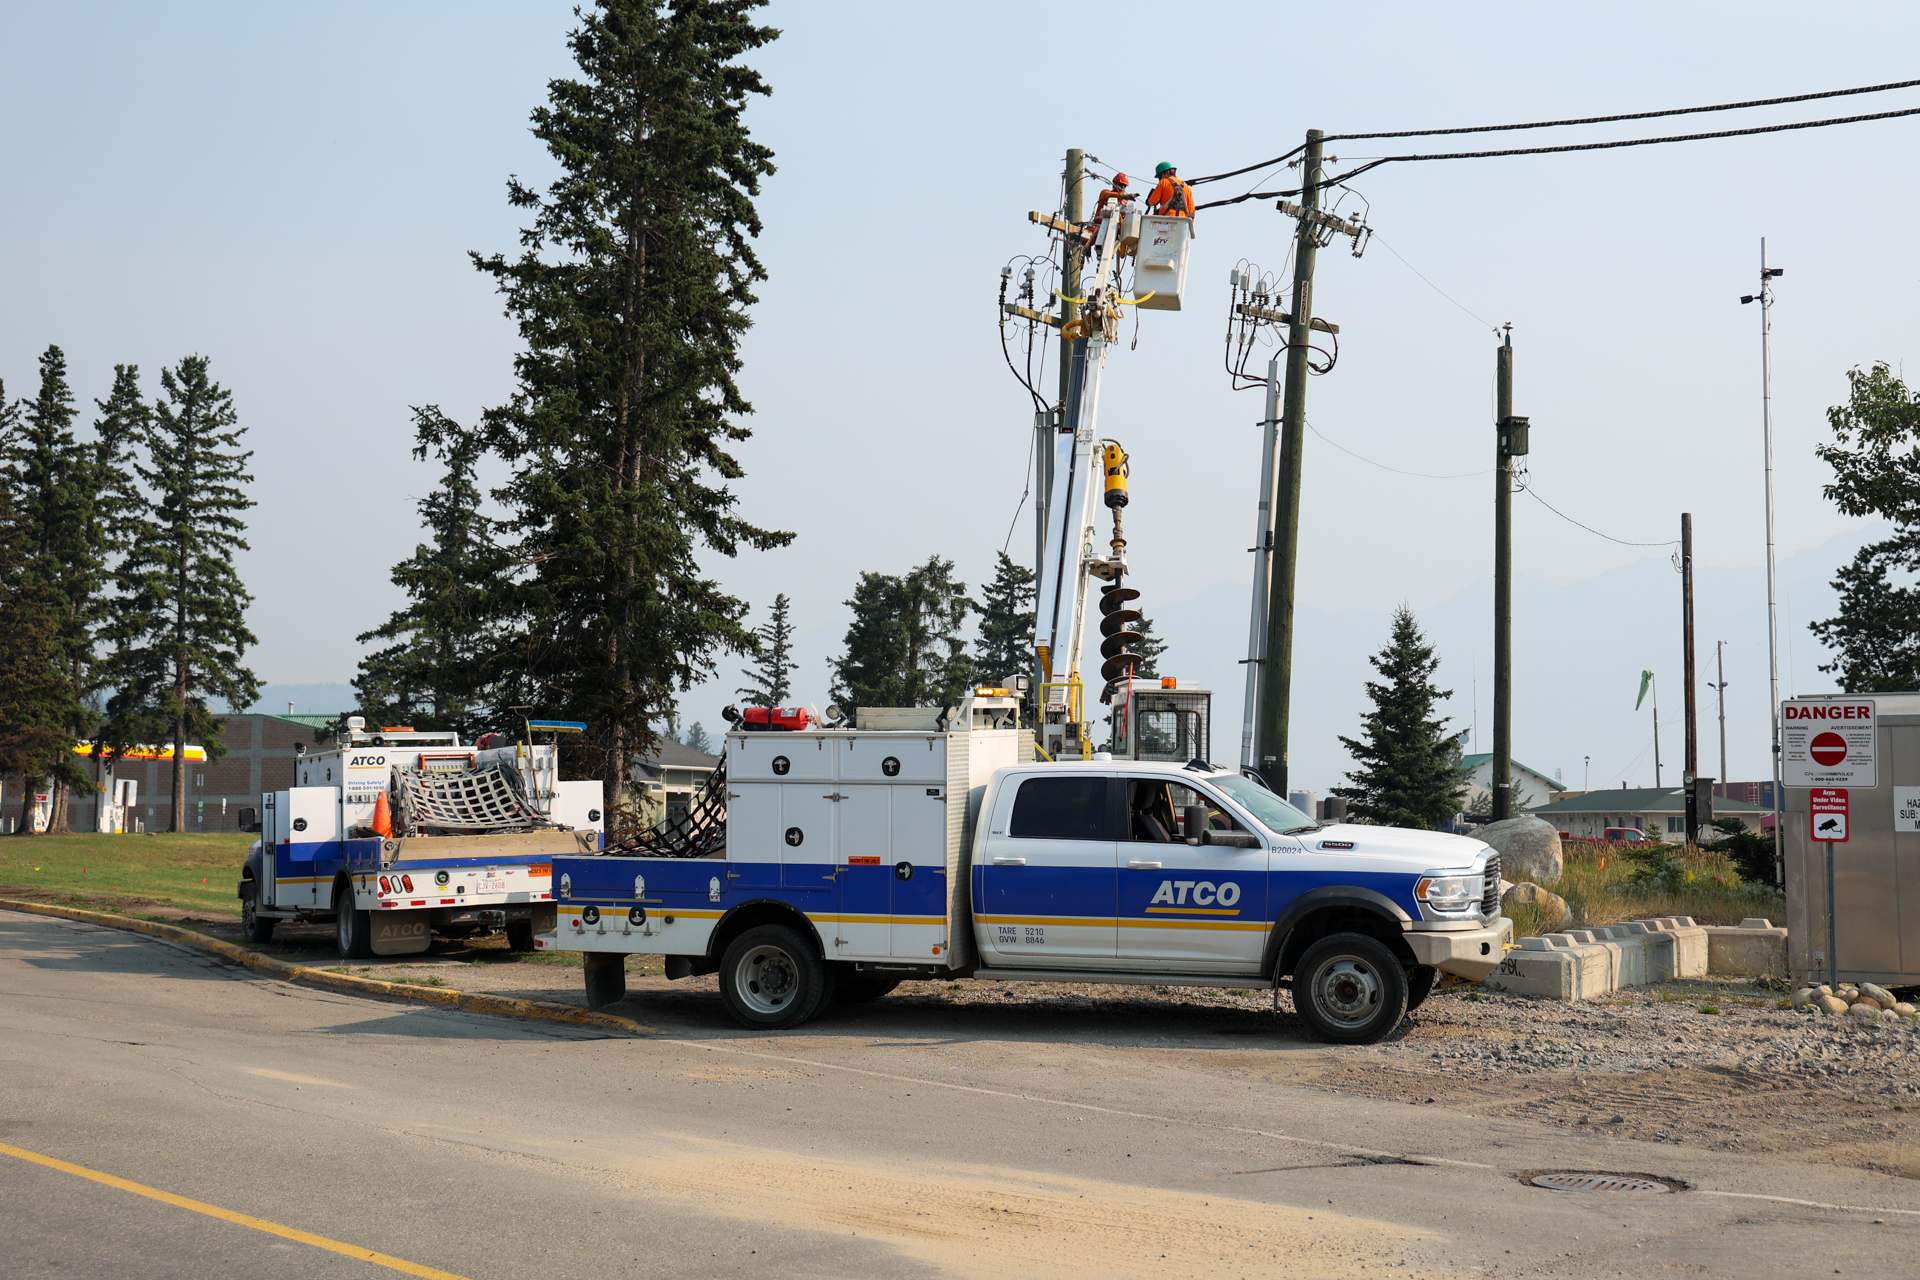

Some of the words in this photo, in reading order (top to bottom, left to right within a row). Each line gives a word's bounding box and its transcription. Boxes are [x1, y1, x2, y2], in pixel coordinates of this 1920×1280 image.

[1786, 706, 1871, 720] DANGER
[350, 756, 386, 766] ATCO
[1900, 809, 1918, 819] SUB:
[1150, 880, 1241, 906] ATCO
[379, 922, 425, 937] ATCO
[998, 927, 1016, 935] TARE
[1025, 928, 1044, 936] 5210
